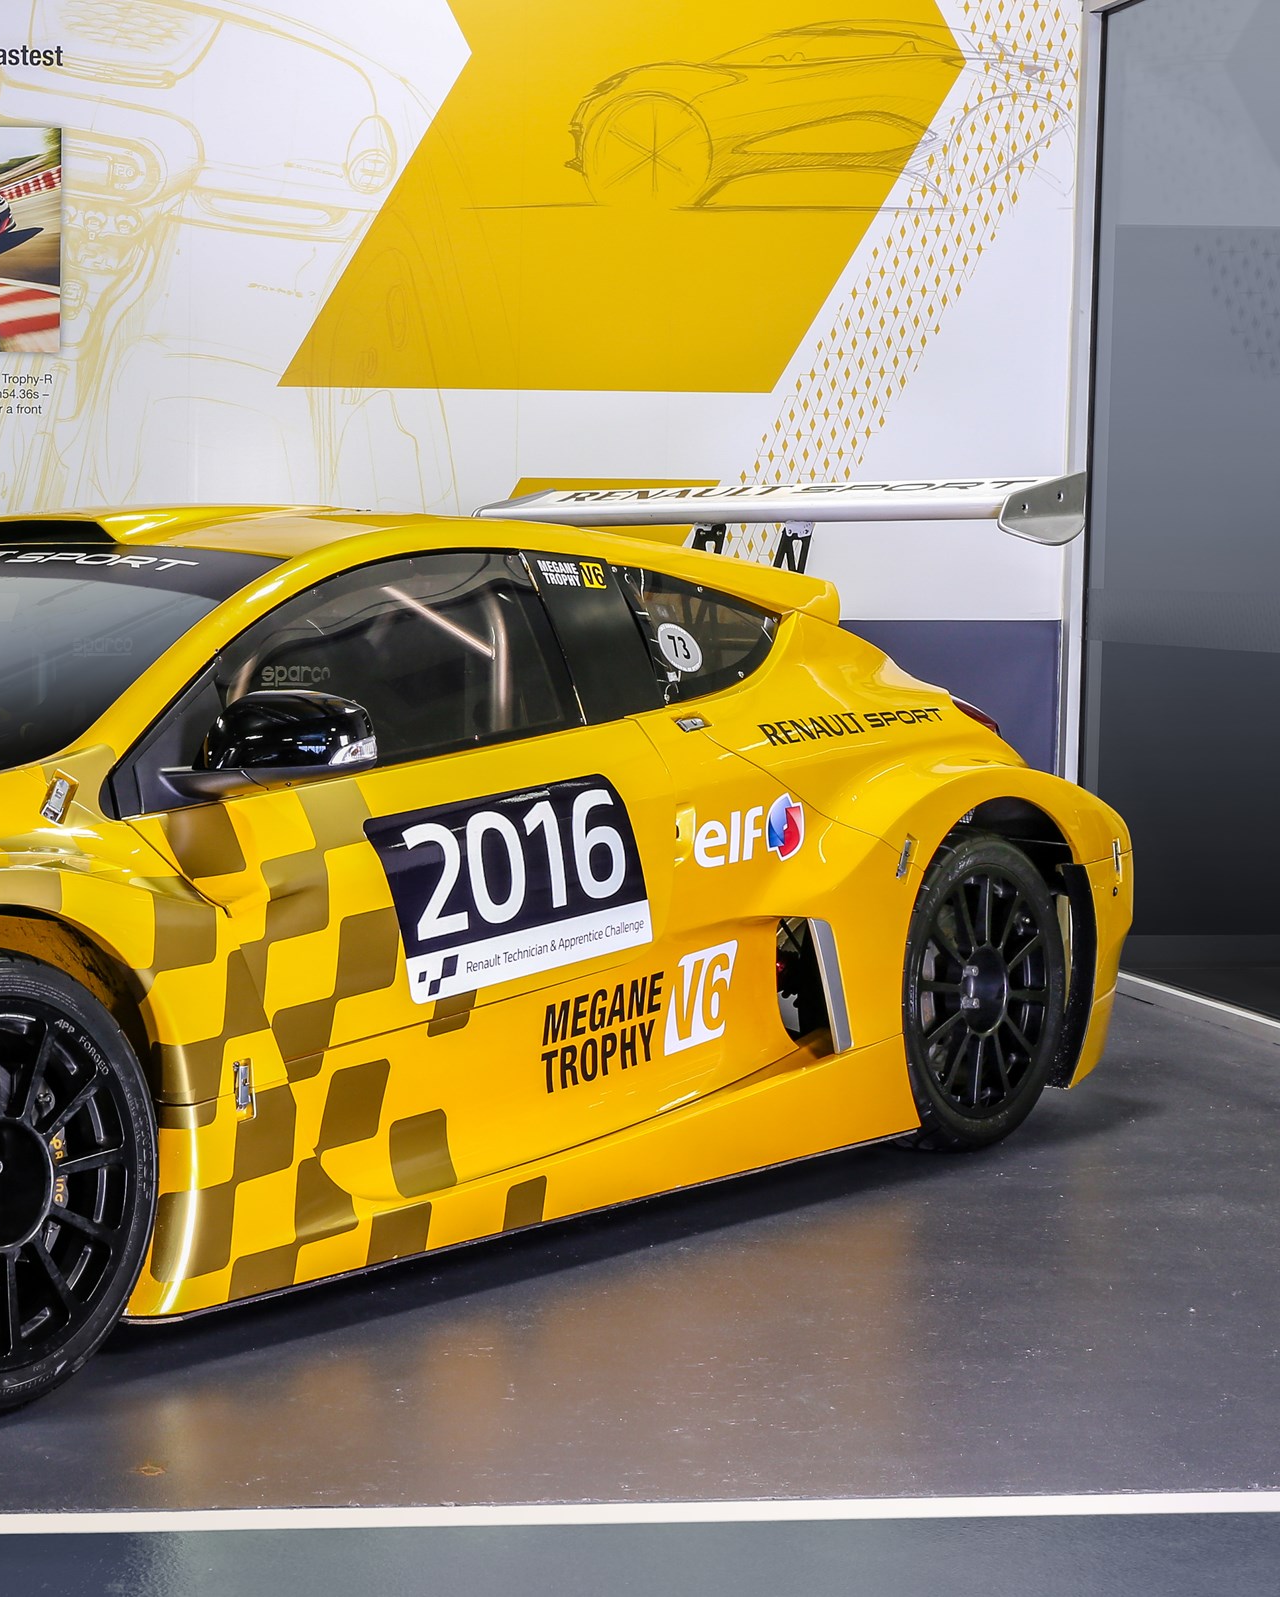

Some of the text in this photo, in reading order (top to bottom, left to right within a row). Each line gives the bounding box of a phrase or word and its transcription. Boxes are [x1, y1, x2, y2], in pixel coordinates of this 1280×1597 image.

[0, 372, 53, 388] Trophy-R
[5, 405, 14, 415] a
[15, 403, 43, 415] front
[557, 478, 1037, 503] RENAULT SPORT
[6, 551, 200, 572] SPORT
[536, 559, 580, 575] MEGANE
[542, 571, 582, 588] TROPHY
[579, 562, 606, 588] V6
[71, 637, 134, 655] sparco
[666, 634, 691, 660] 73
[757, 707, 943, 747] RENAULT SPORT
[693, 803, 764, 869] elf
[401, 788, 627, 942] 2016
[465, 919, 645, 974] Renault Technician & Apprentice Challenge
[542, 970, 665, 1047] MEGANE
[667, 944, 734, 1050] V6
[540, 1018, 656, 1094] TROPHY
